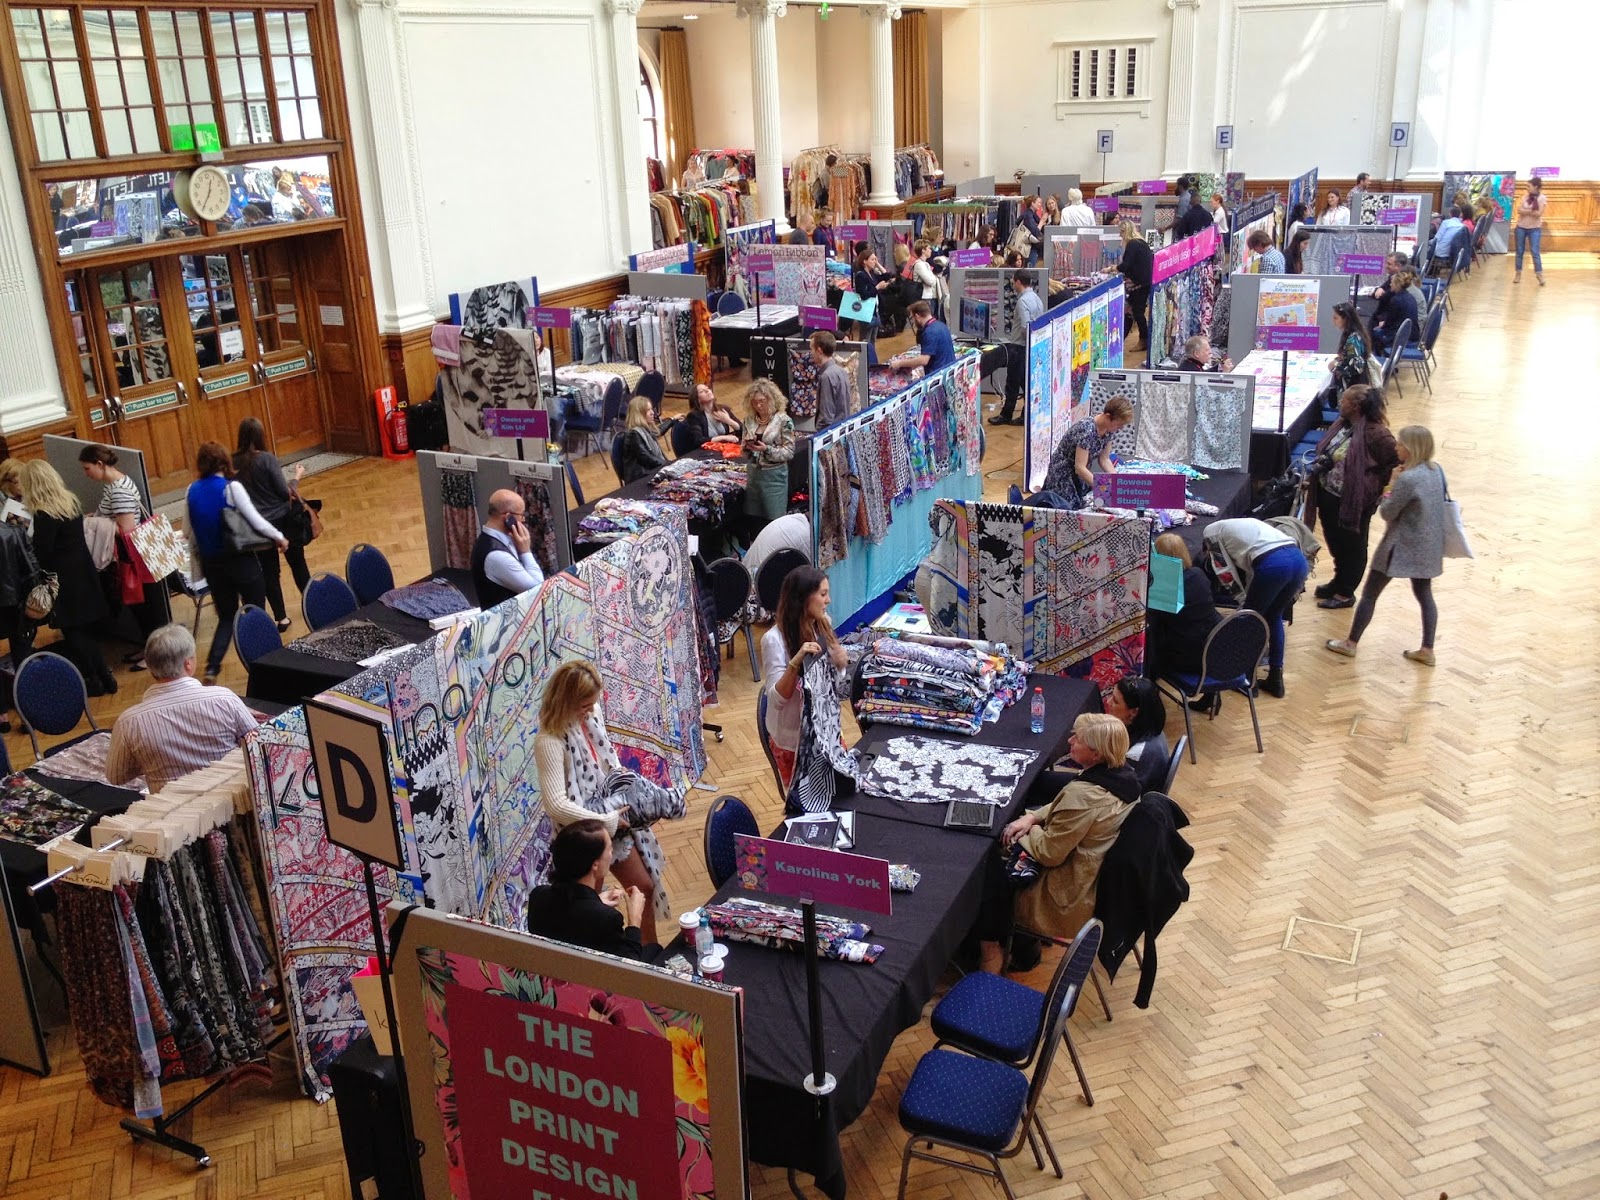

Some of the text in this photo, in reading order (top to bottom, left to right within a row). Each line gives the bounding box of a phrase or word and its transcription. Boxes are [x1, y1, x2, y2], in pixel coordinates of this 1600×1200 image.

[1101, 135, 1110, 147] F
[1220, 131, 1229, 144] E
[1393, 128, 1405, 141] D
[753, 246, 819, 258] Lemon Ribbon
[132, 401, 146, 410] Push
[515, 423, 526, 431] Ltd
[1117, 478, 1152, 486] Rowena
[325, 740, 378, 824] D
[774, 861, 882, 890] Karolina York
[517, 1012, 594, 1059] THE
[484, 1047, 639, 1119] LONDON
[509, 1098, 619, 1156] PRINT
[501, 1137, 638, 1200] DESIGN
